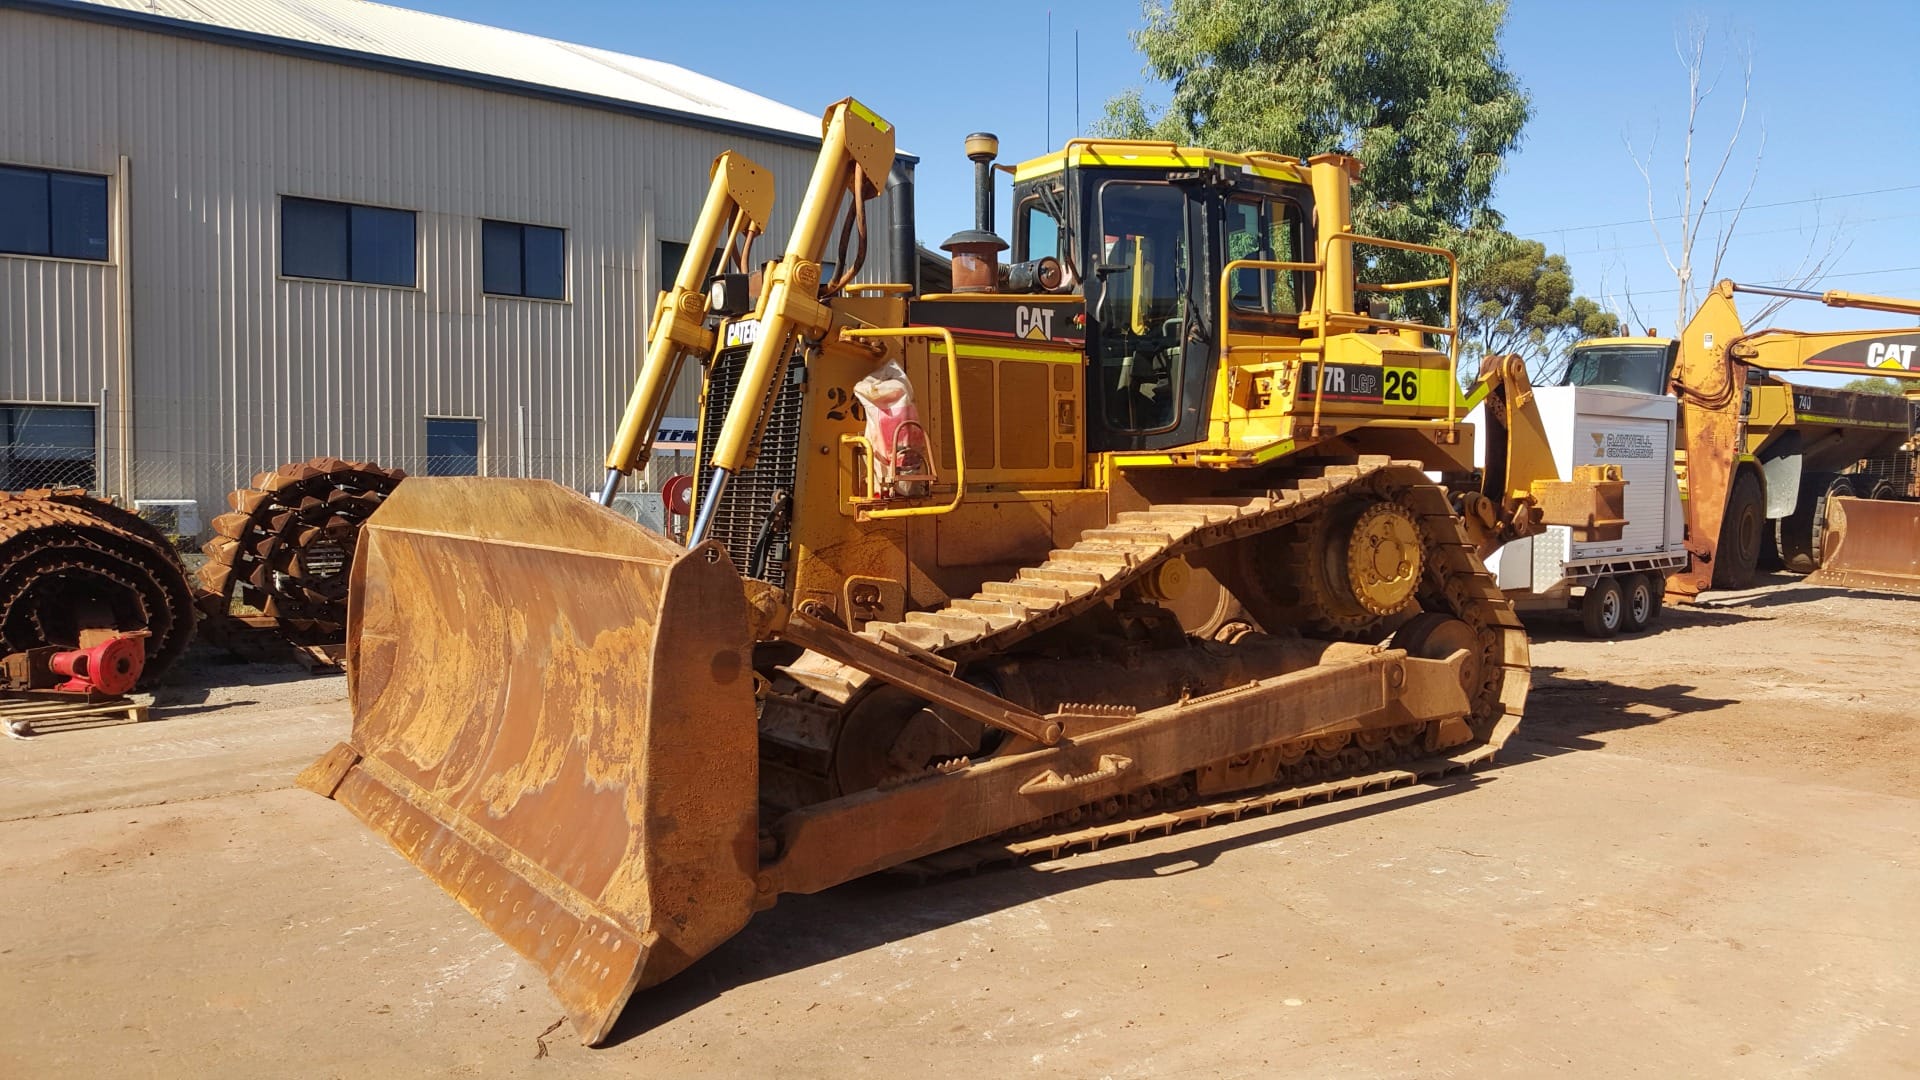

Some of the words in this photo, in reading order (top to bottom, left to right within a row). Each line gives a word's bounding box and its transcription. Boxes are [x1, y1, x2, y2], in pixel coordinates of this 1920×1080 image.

[1015, 305, 1055, 341] CAT
[1866, 342, 1917, 370] CAT
[1351, 373, 1377, 394] LGP
[1384, 370, 1418, 401] 26
[1798, 395, 1812, 410] 740
